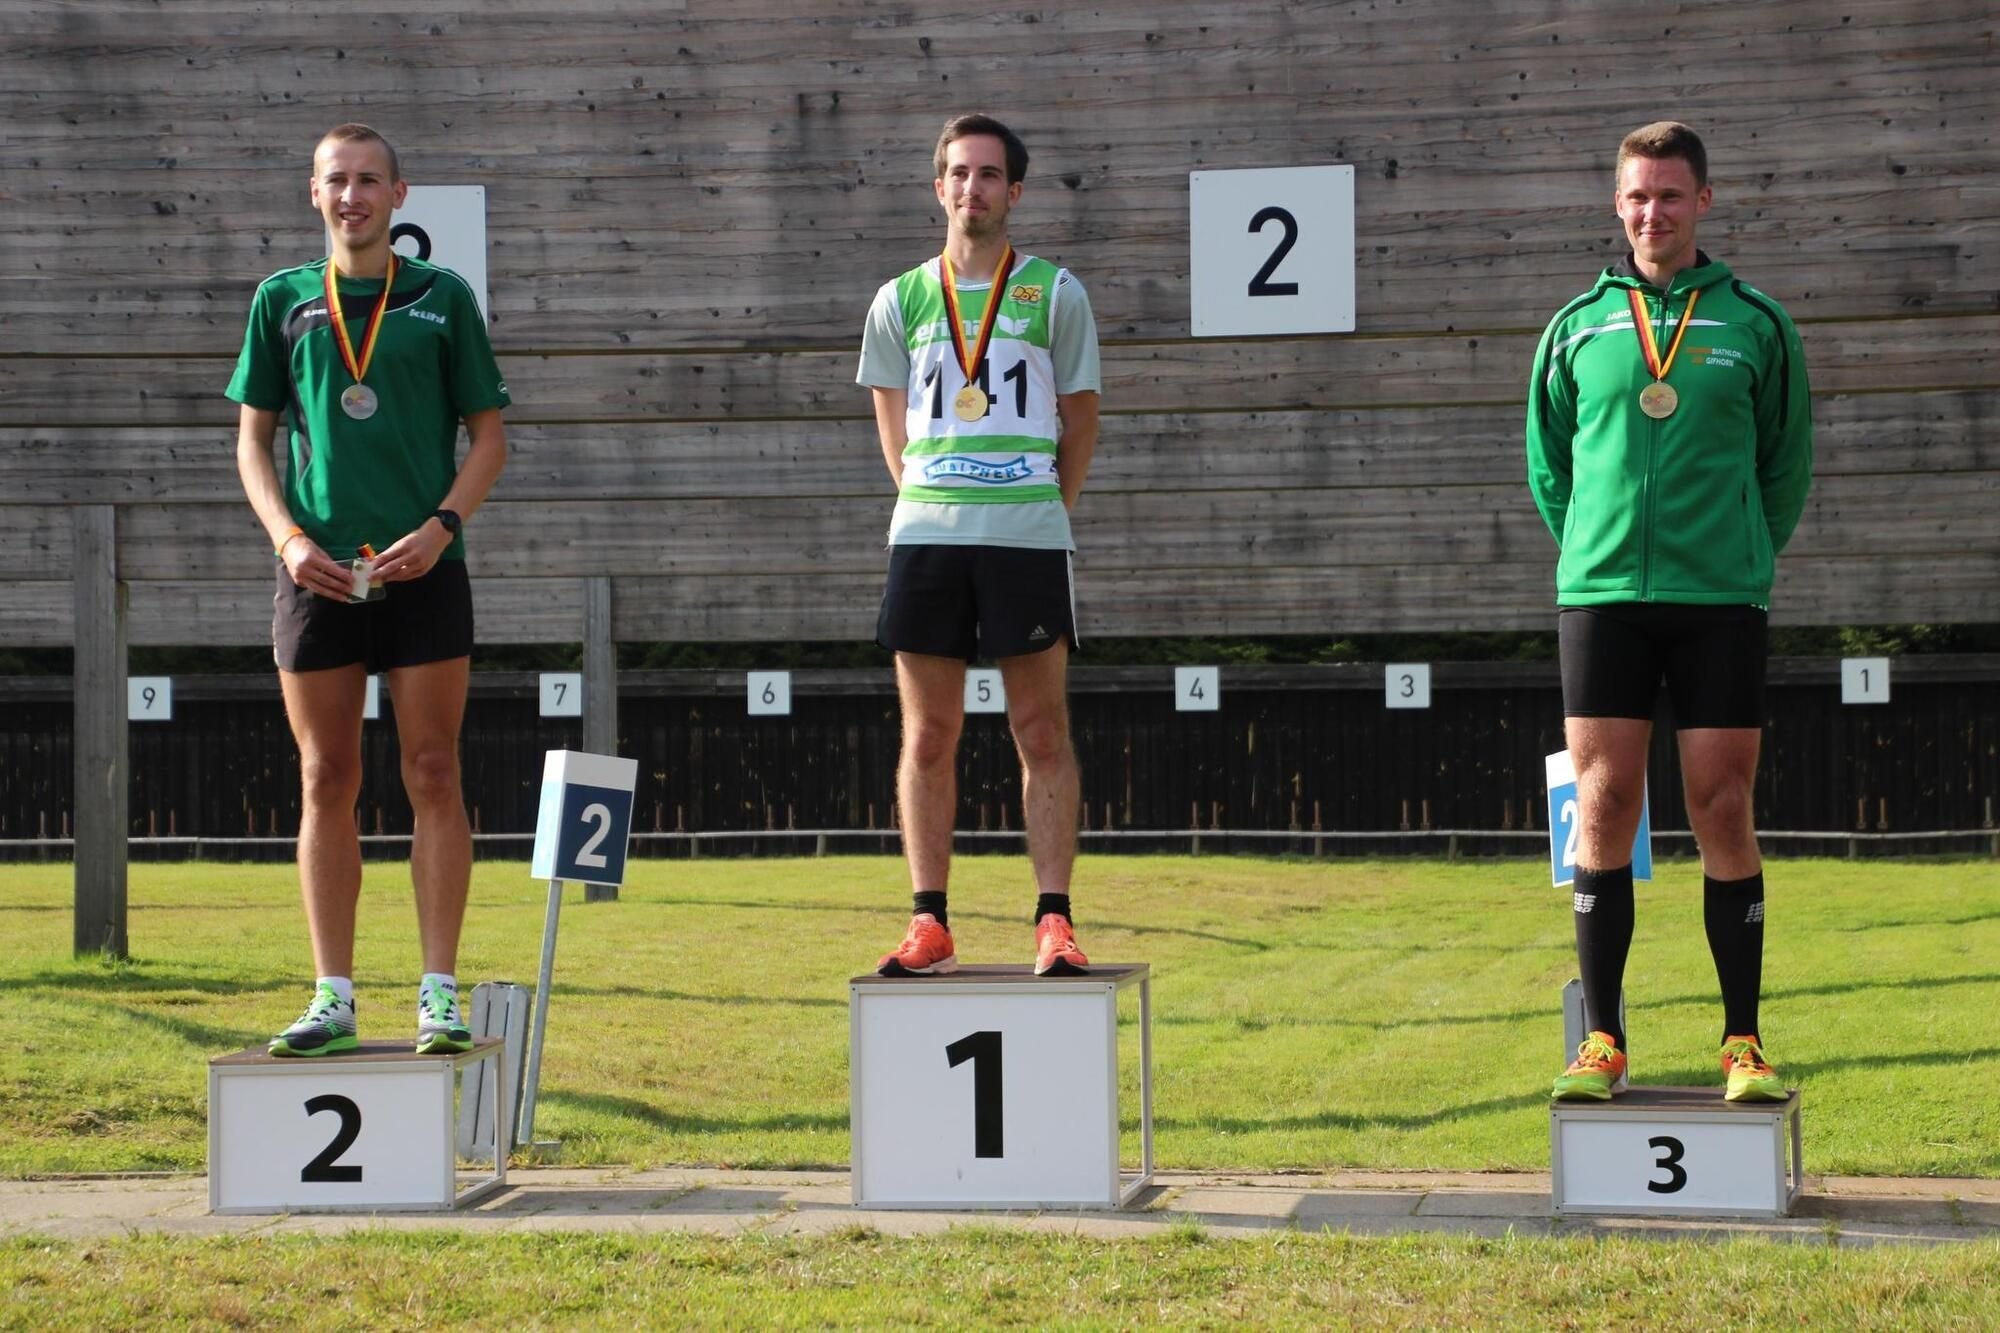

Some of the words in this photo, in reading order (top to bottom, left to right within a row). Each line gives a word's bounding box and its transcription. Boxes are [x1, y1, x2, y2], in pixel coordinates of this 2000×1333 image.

[1247, 206, 1299, 297] 2
[977, 679, 991, 703] 5
[1189, 676, 1204, 700] 4
[1401, 674, 1414, 698] 3
[1859, 668, 1869, 693] 1
[142, 686, 156, 710] 9
[553, 682, 567, 706] 7
[762, 681, 775, 705] 6
[574, 802, 612, 868] 2
[944, 1030, 1004, 1159] 1
[300, 1094, 363, 1183] 2
[1647, 1135, 1688, 1194] 3
